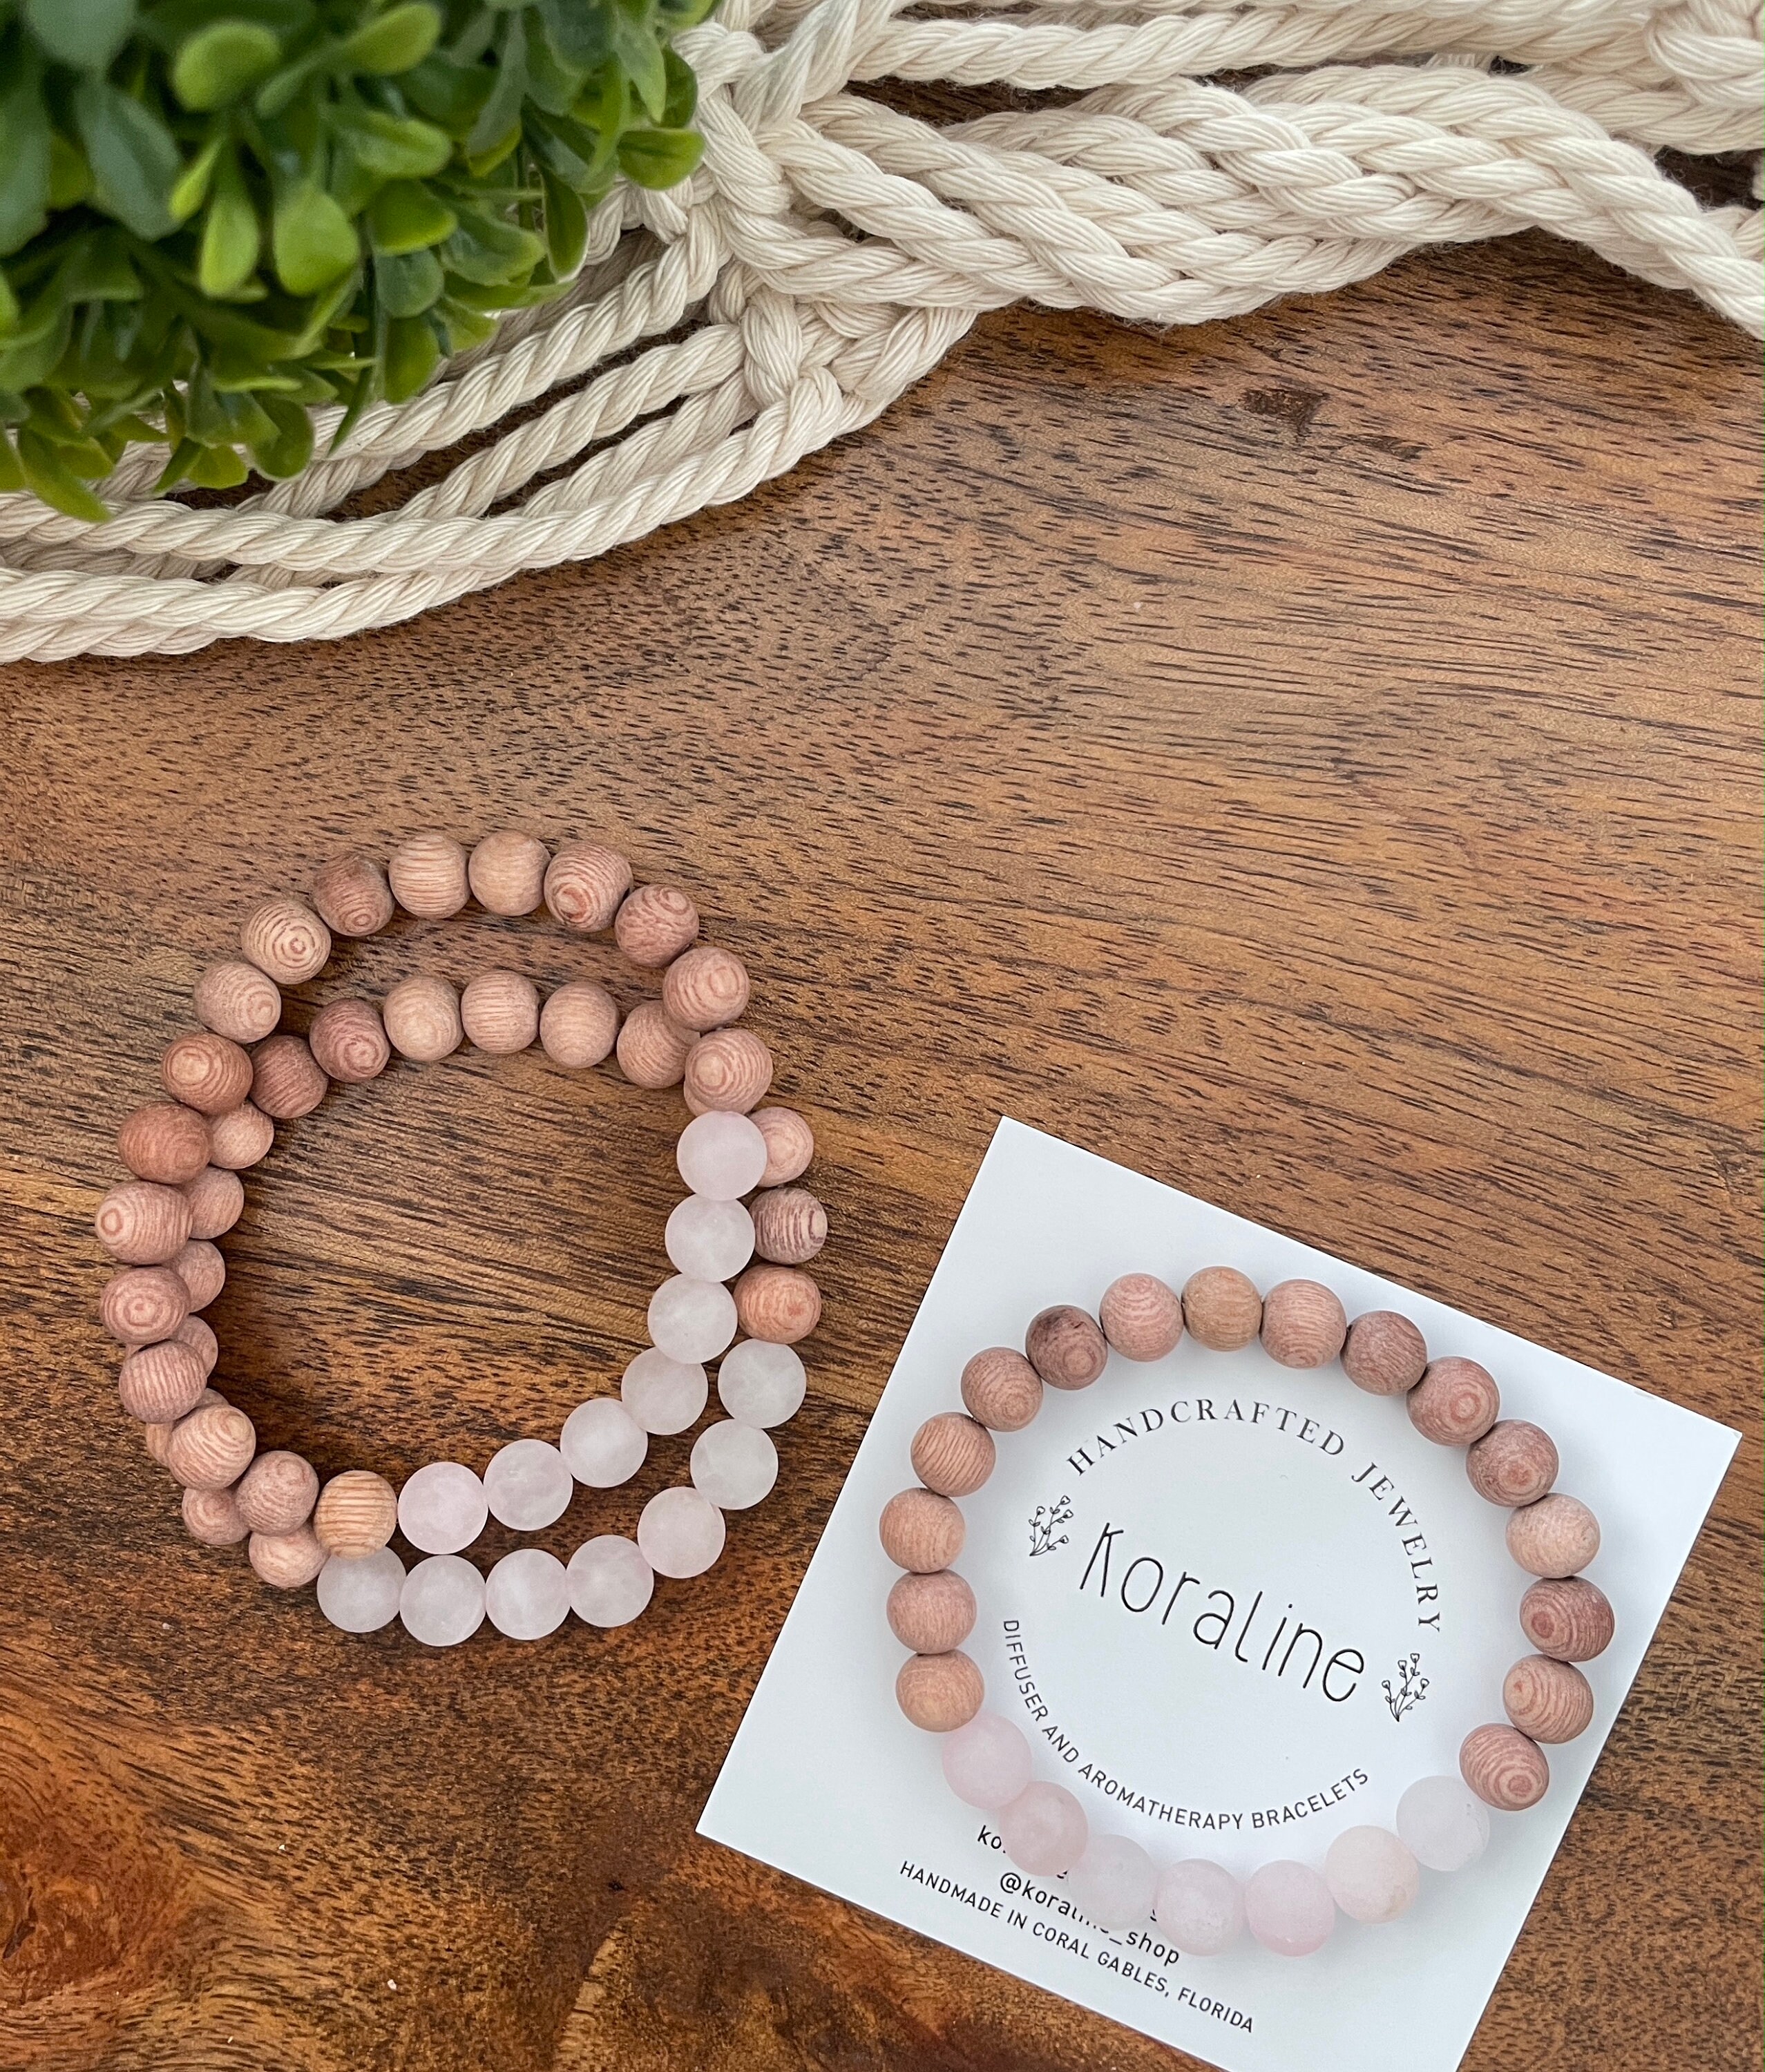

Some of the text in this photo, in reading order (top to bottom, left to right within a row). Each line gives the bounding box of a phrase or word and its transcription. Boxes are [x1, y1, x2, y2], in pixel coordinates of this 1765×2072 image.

[1065, 1398, 1441, 1633] HANDCRAFTED JEWELRY
[1078, 1521, 1366, 1703] Koraline
[1002, 1619, 1369, 1831] DIFFUSER AND AROMATHERAPY BRACELETS
[899, 1859, 1004, 1919] HANDMADE
[1006, 1908, 1029, 1930] IN
[1031, 1921, 1090, 1960] CORAL
[1096, 1950, 1170, 1999] GABLES,
[1176, 1986, 1253, 2034] FLORIDA
[999, 1871, 1180, 1966] @koral_shop
